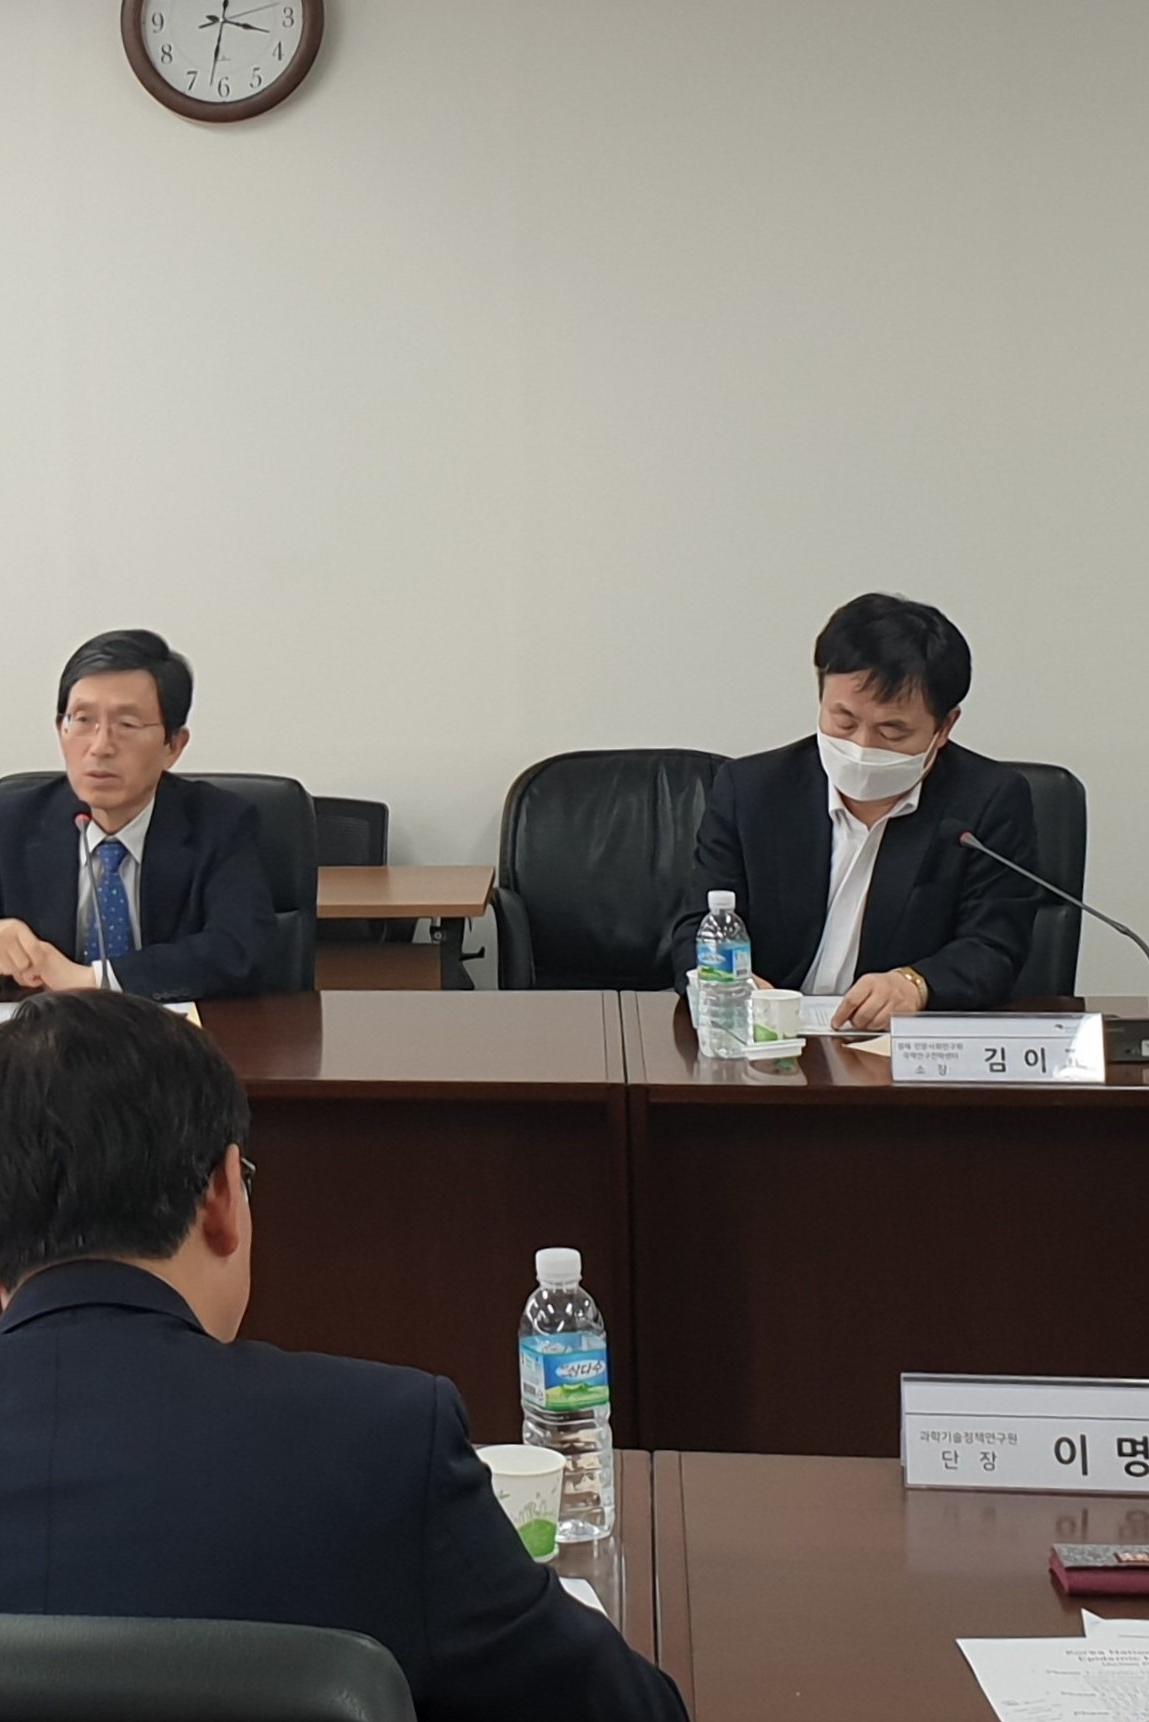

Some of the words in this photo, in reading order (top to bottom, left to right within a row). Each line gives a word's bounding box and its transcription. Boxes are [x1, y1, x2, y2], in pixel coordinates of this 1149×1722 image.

[152, 12, 164, 33] 9
[282, 7, 294, 28] 3
[161, 44, 173, 65] 8
[272, 41, 284, 61] 4
[186, 71, 198, 91] 7
[218, 77, 230, 97] 6
[250, 67, 262, 88] 5
[919, 1430, 1018, 1445] 과학기술정책연구원
